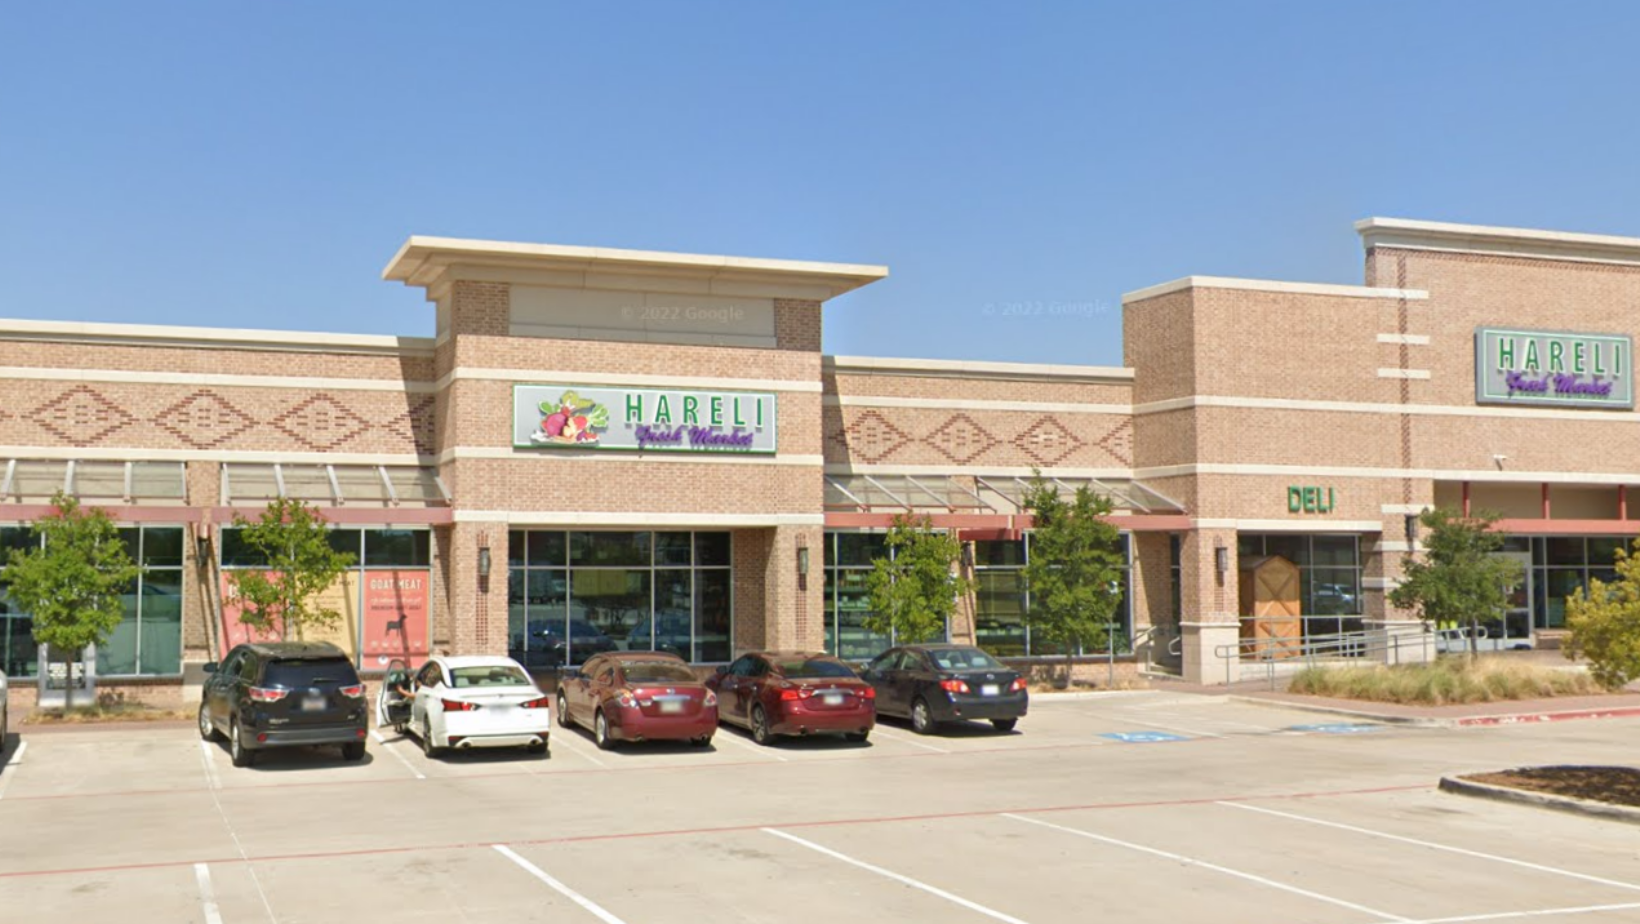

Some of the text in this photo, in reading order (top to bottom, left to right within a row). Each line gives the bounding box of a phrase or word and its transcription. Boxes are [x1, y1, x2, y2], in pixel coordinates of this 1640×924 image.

[1499, 338, 1621, 374] HARELI
[1553, 372, 1612, 395] Market
[625, 394, 763, 426] HARELI
[688, 426, 753, 446] Market
[1287, 485, 1335, 513] DELI
[370, 578, 421, 590] GOAT MEAT
